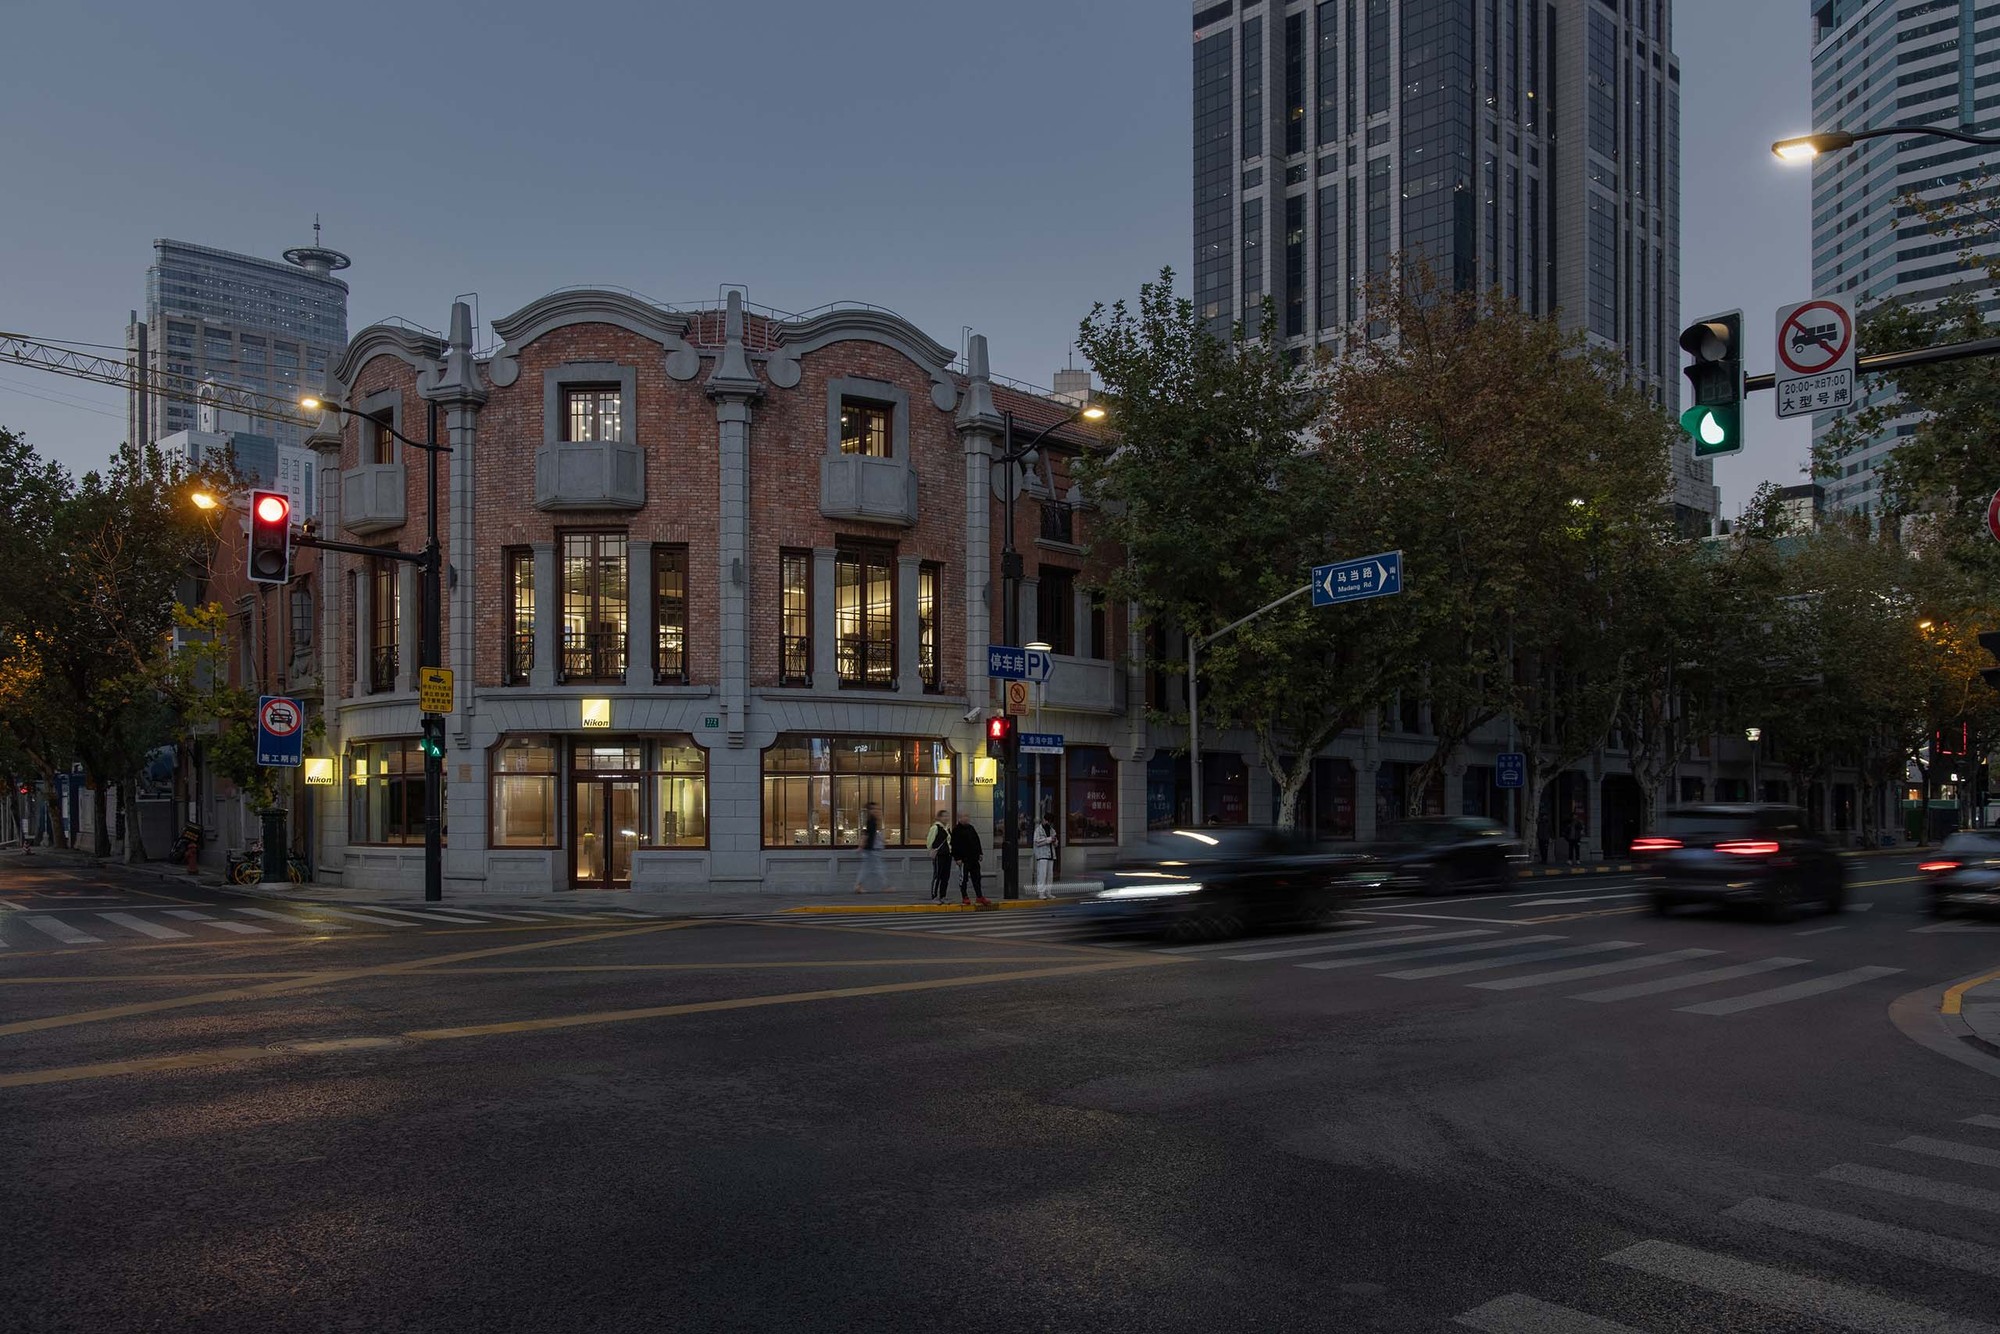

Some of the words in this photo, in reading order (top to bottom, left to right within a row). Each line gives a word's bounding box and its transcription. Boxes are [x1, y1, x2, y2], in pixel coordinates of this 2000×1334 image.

[1783, 389, 1848, 411] 大型号牌
[1338, 567, 1373, 582] 马当路
[1338, 584, 1360, 592] Madang
[991, 653, 1024, 672] 停车库
[1028, 653, 1040, 676] P
[583, 719, 609, 727] Nikon
[261, 753, 299, 764] 施工期间
[306, 775, 332, 784] Nikon
[975, 776, 994, 784] Nikon
